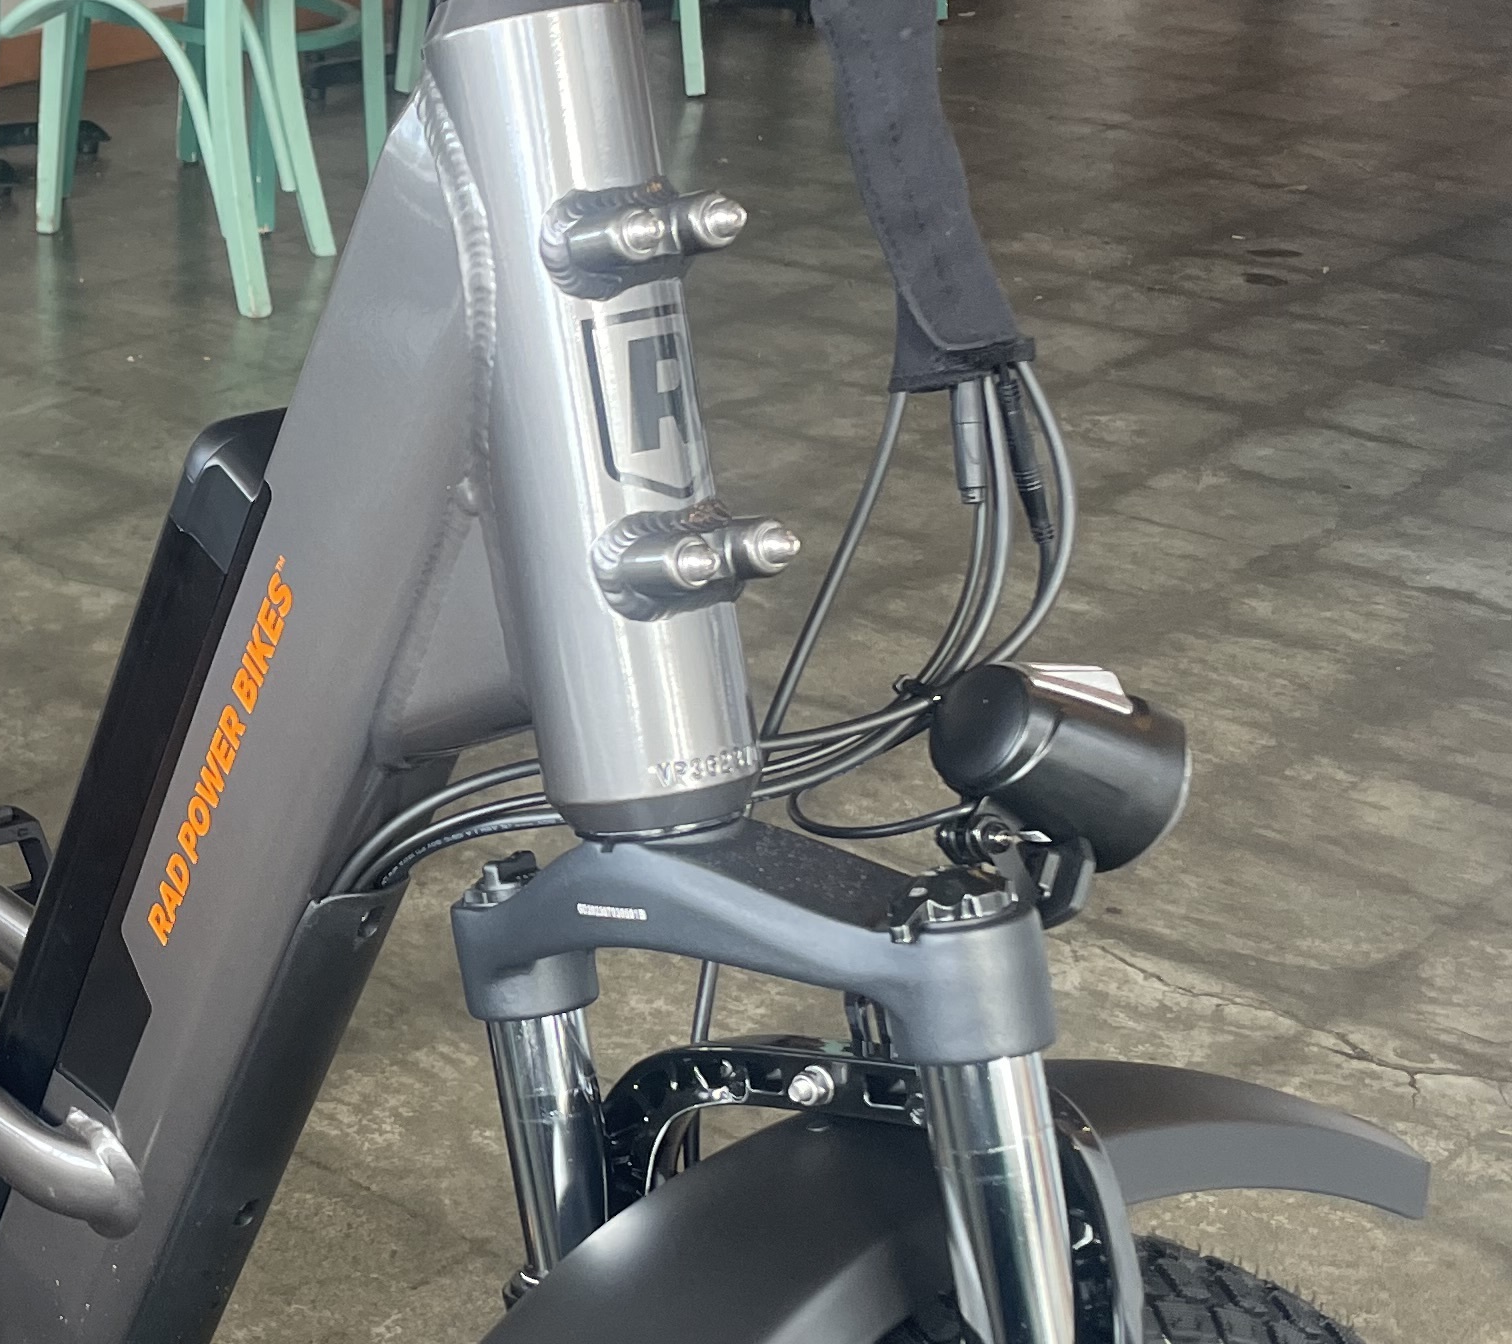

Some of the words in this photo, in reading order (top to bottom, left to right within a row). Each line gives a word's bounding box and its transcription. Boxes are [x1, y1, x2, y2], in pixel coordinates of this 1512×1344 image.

[146, 852, 192, 947] RAD
[176, 703, 248, 865] POWER
[231, 571, 295, 715] BIKES
